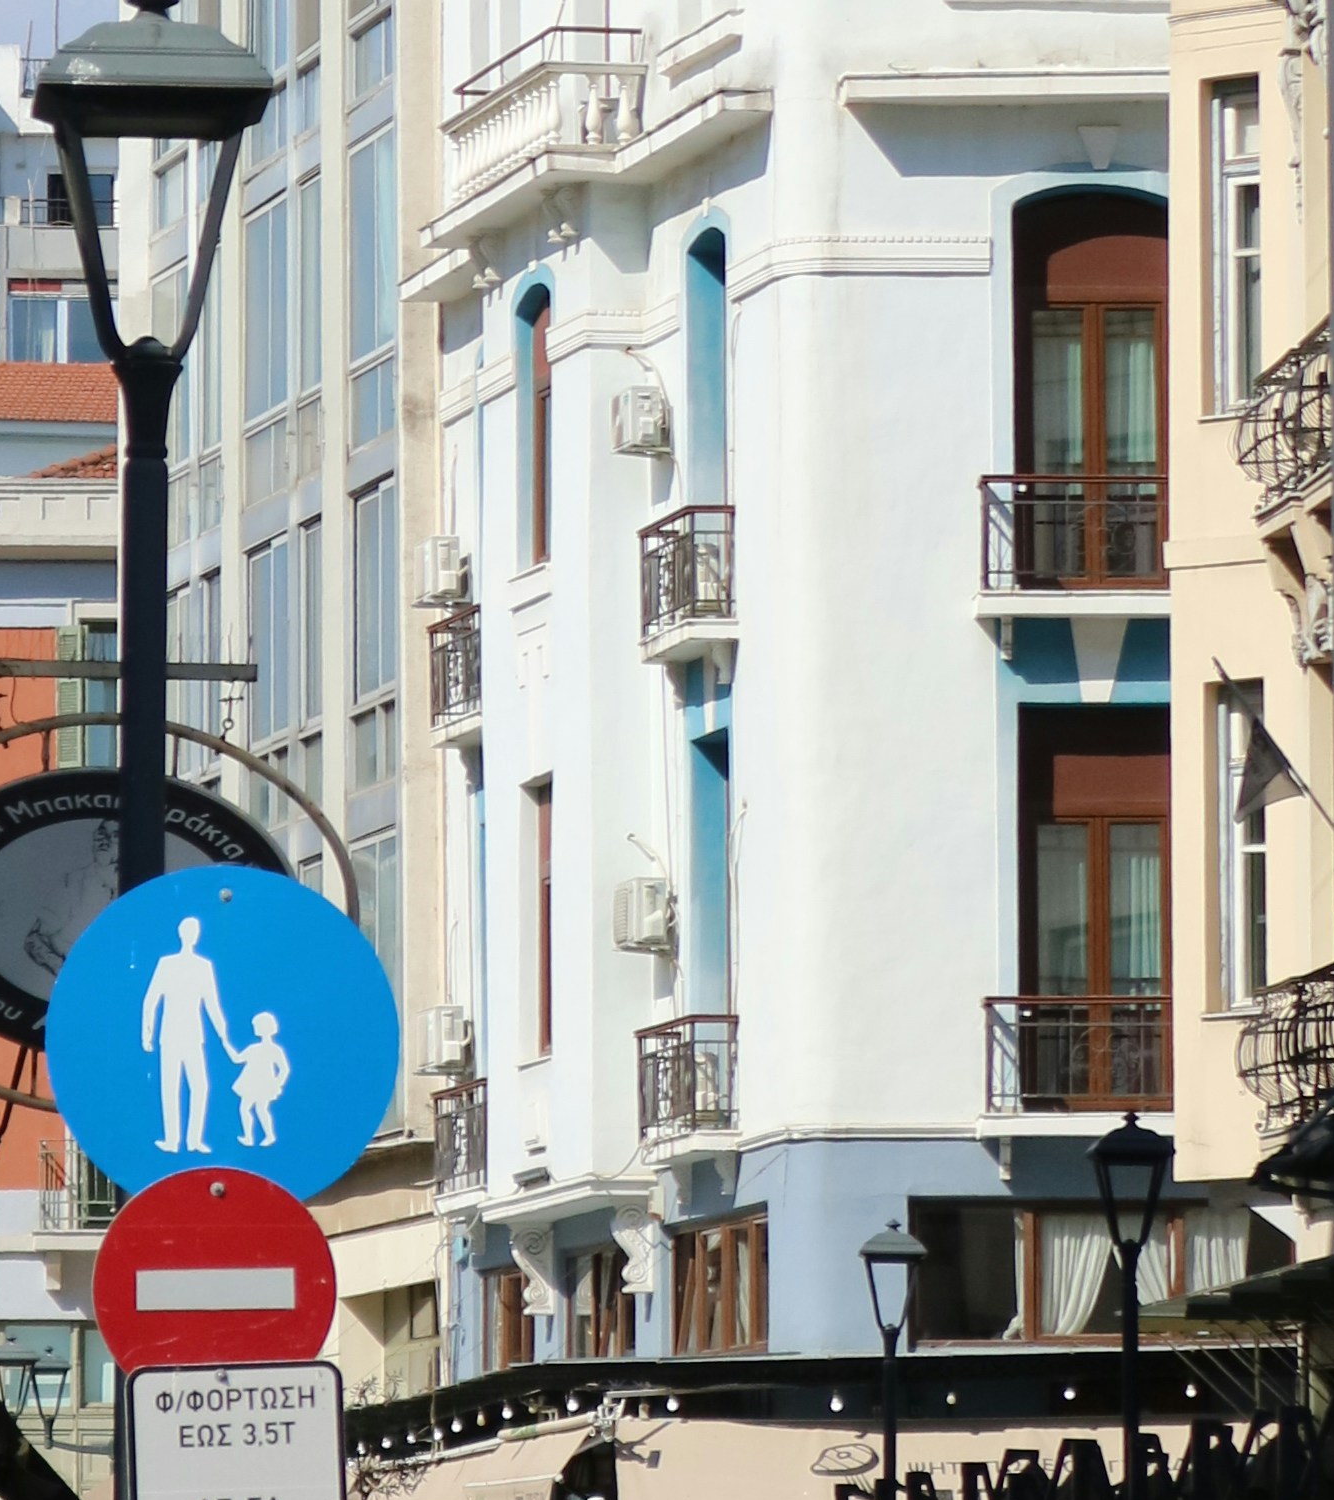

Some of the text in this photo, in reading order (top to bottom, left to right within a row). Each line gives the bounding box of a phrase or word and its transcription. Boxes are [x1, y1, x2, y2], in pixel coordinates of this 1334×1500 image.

[4, 793, 244, 860] Μπακαράκια
[155, 1385, 316, 1413] Φ/ΦΟΡΤΩΣΗ
[179, 1424, 232, 1448] ΕΩΣ
